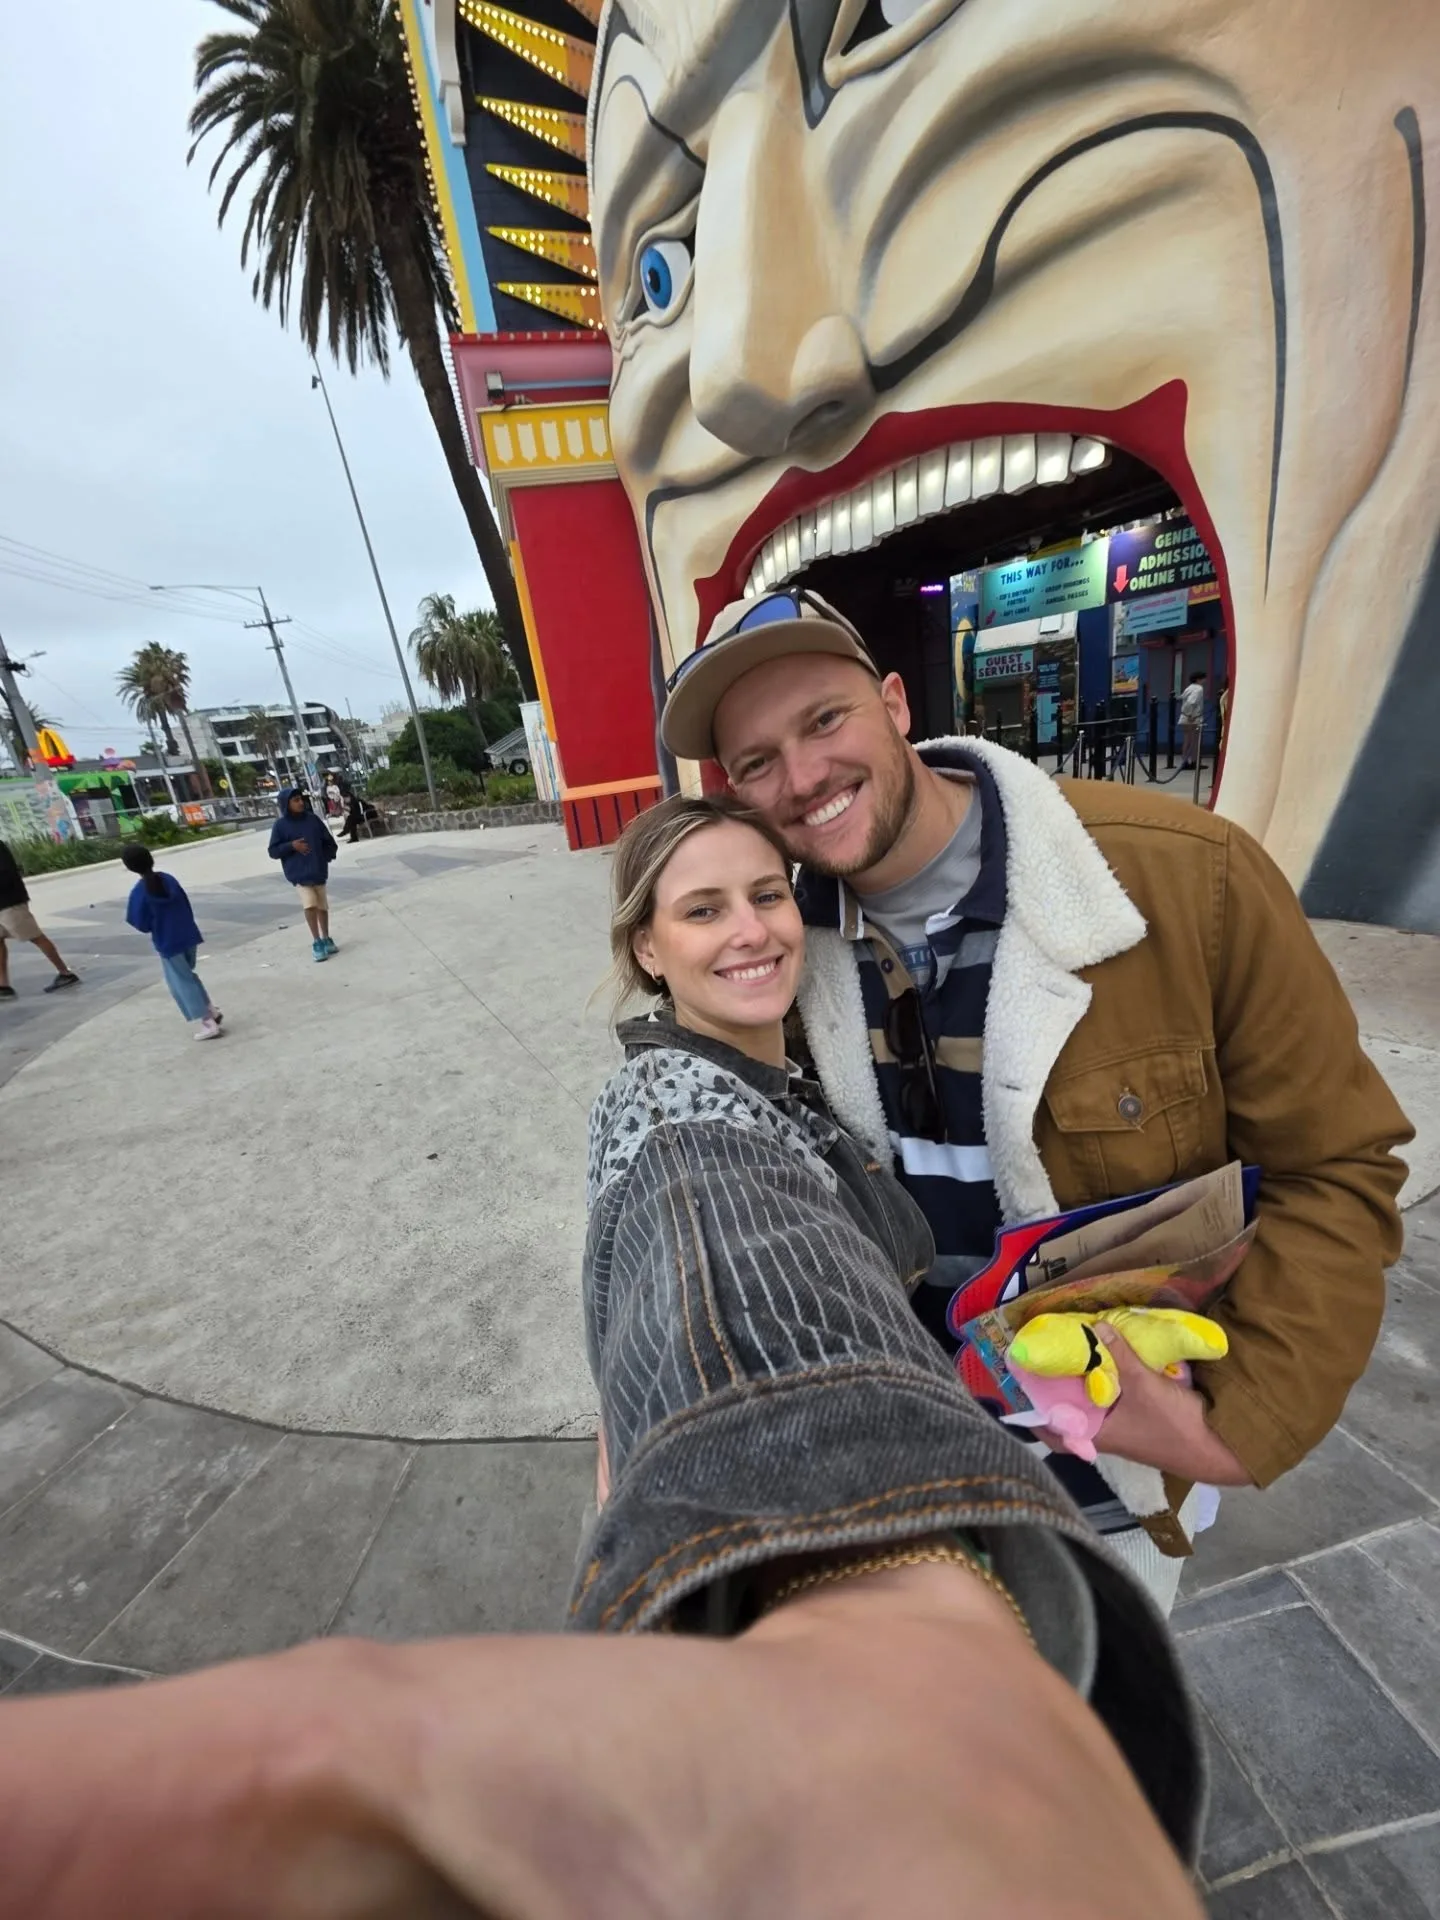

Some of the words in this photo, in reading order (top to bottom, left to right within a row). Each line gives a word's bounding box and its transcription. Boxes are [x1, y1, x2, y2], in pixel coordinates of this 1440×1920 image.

[1155, 527, 1200, 549] GENER
[1139, 544, 1209, 572] ADMISSIO
[1001, 570, 1022, 585] THIS
[1026, 562, 1049, 578] WAY
[1051, 556, 1085, 572] FOR...
[1129, 569, 1176, 591] ONLINE
[978, 662, 1032, 678] SERVICES
[986, 654, 1023, 667] GUEST
